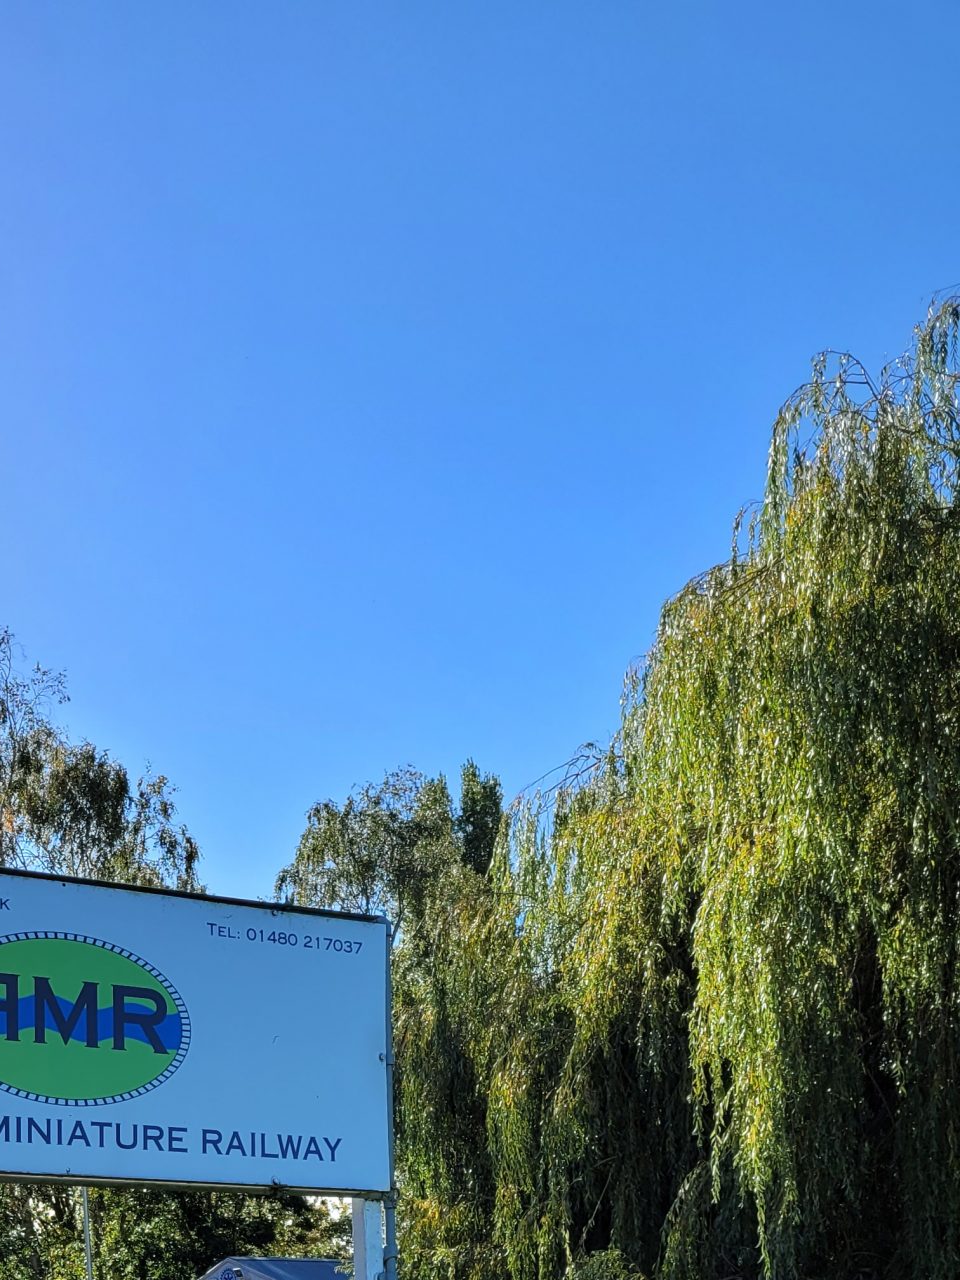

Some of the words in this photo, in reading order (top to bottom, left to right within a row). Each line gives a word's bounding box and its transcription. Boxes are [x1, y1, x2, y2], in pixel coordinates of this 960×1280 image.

[246, 928, 298, 946] 01480
[303, 936, 363, 954] 217037
[201, 1128, 342, 1162] RAILWAY
